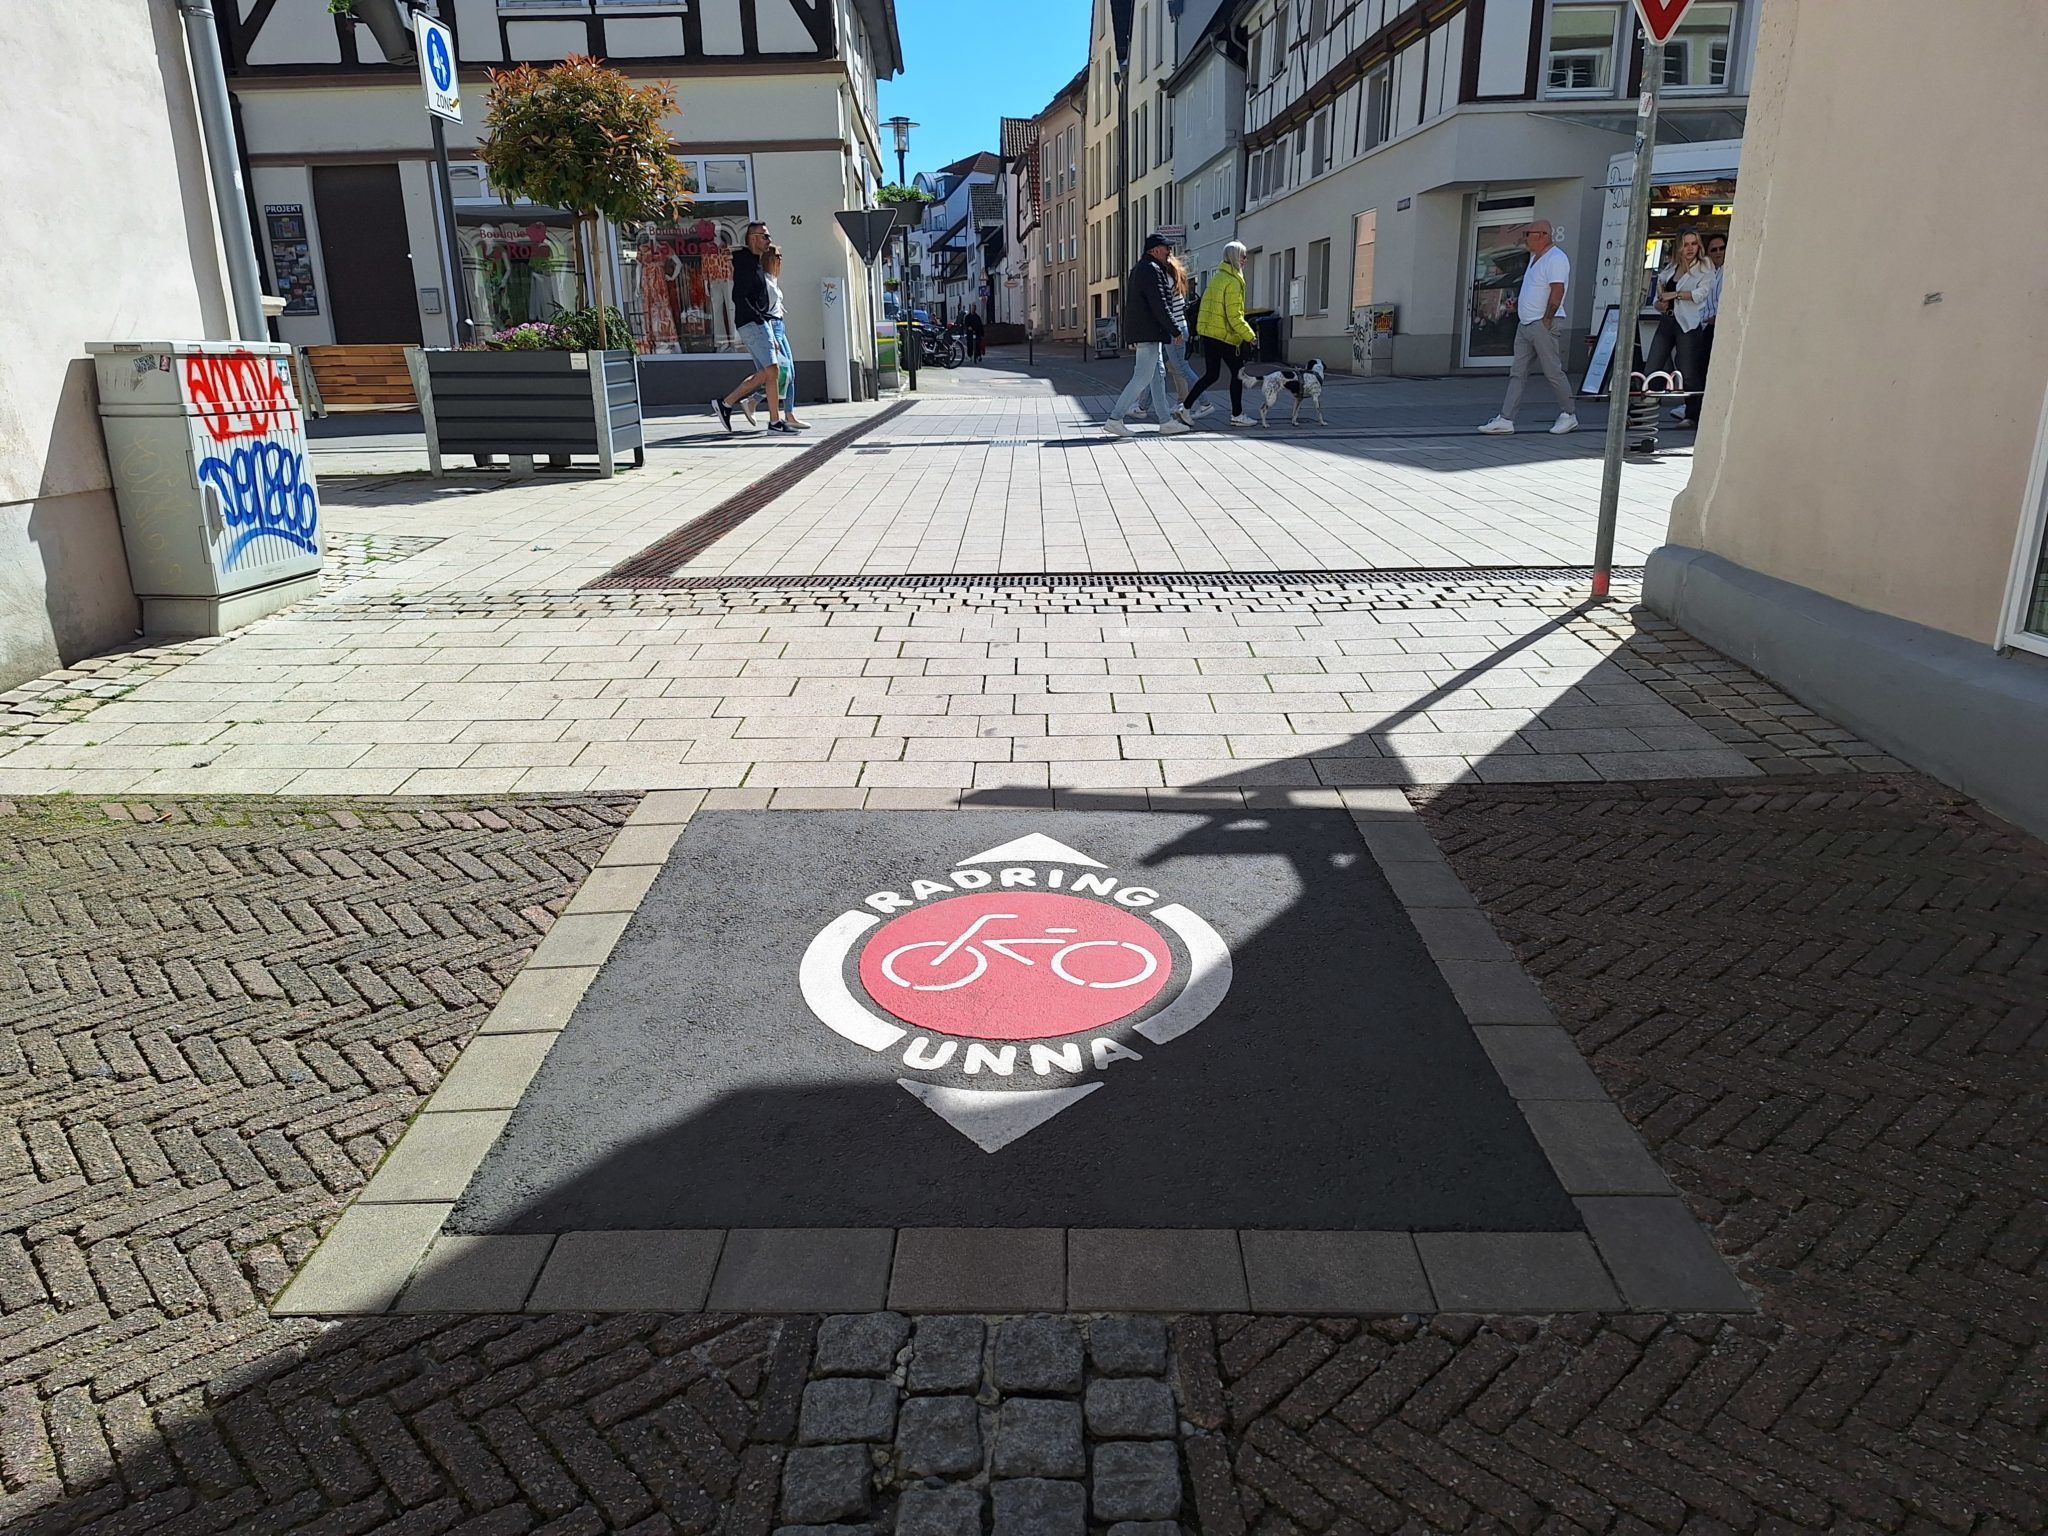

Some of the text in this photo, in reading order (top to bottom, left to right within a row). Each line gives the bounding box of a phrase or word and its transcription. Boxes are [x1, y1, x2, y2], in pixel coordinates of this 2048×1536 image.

[435, 92, 454, 113] ZONE
[265, 205, 301, 213] PROJEKT
[790, 215, 803, 225] 26
[480, 229, 528, 243] Boutique
[650, 240, 671, 256] La
[865, 867, 1159, 914] RADRING
[902, 1037, 1143, 1076] UNNA
